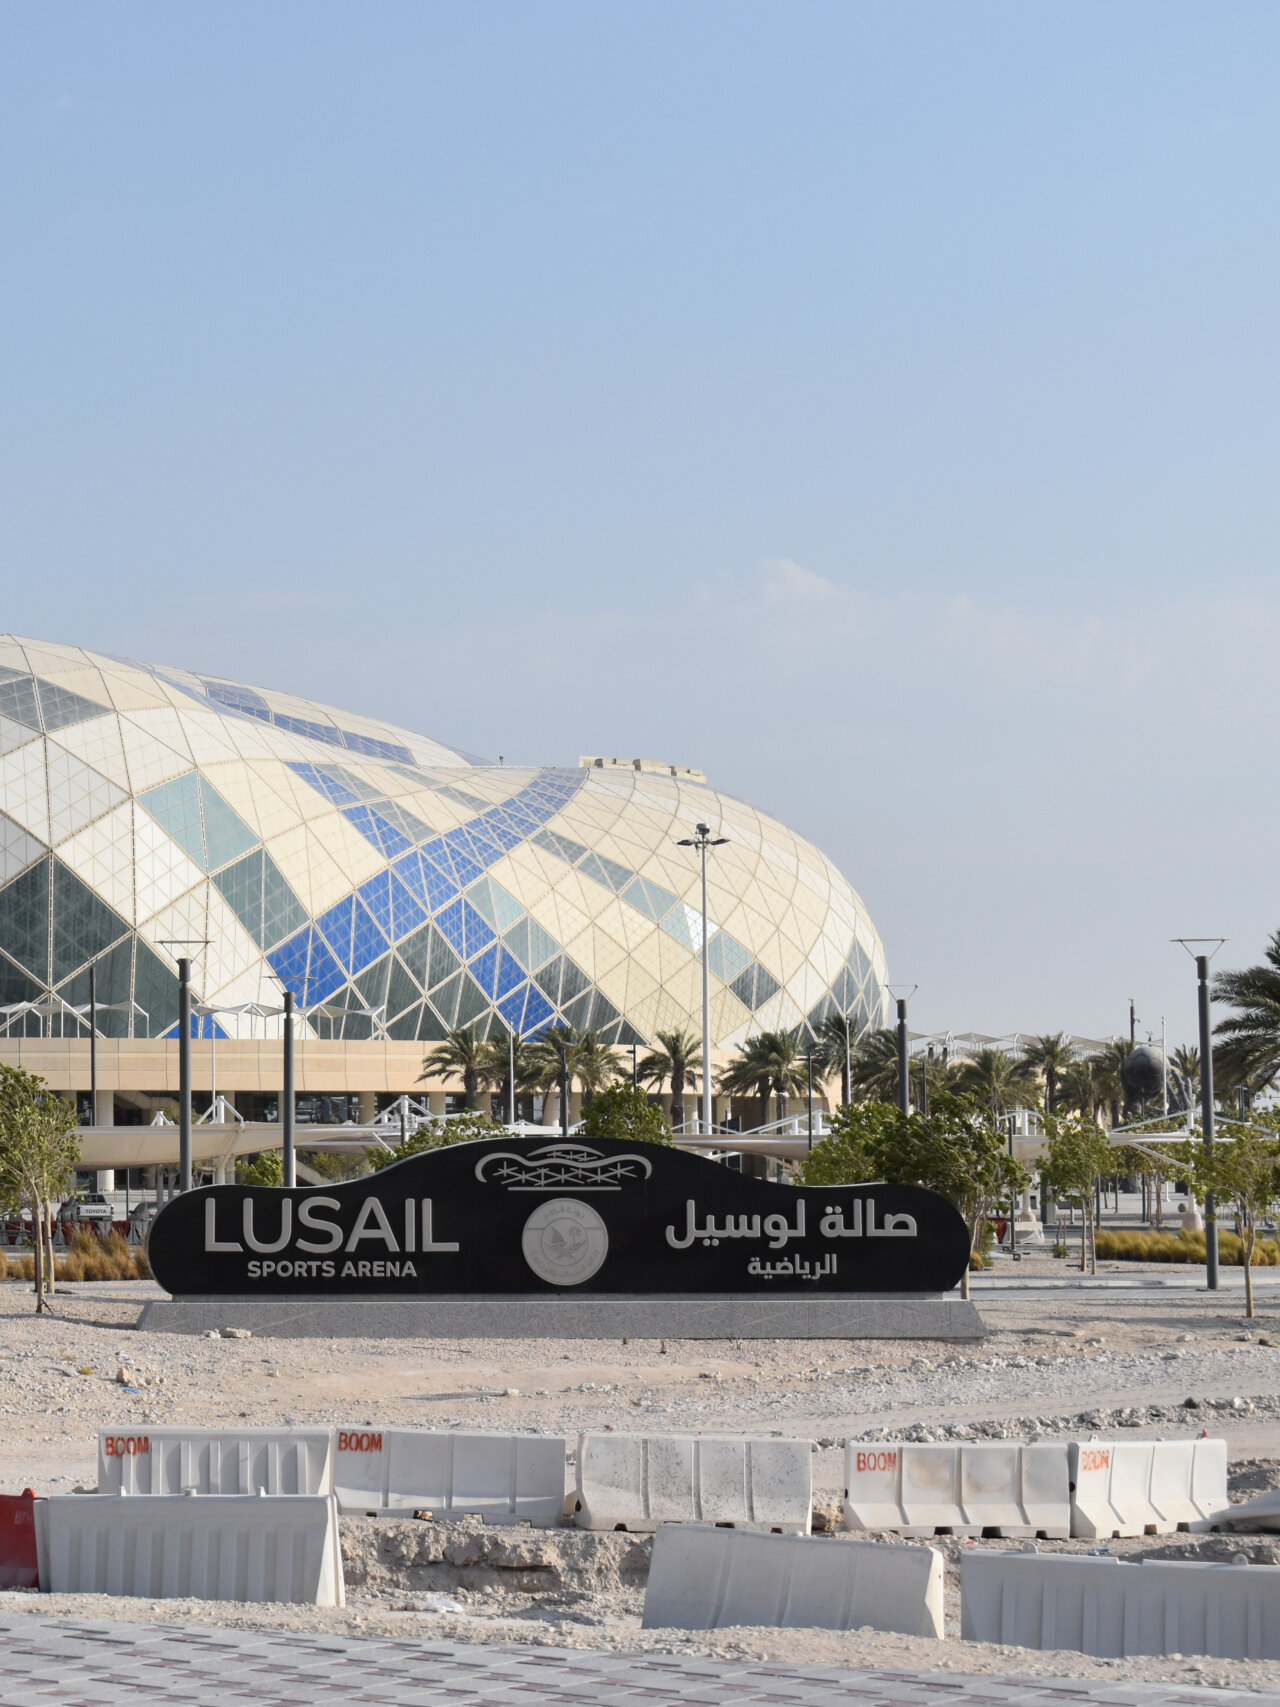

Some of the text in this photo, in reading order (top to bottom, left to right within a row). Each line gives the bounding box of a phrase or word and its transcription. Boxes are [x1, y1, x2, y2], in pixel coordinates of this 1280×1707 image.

[204, 1196, 460, 1254] LUSAIL
[665, 1198, 918, 1250] صالة لوسيل
[247, 1260, 418, 1278] SPORTS ARENA
[747, 1253, 838, 1280] الرياضية
[105, 1436, 149, 1457] BOOM
[338, 1432, 383, 1452] BOOM
[856, 1451, 897, 1472] BOOM
